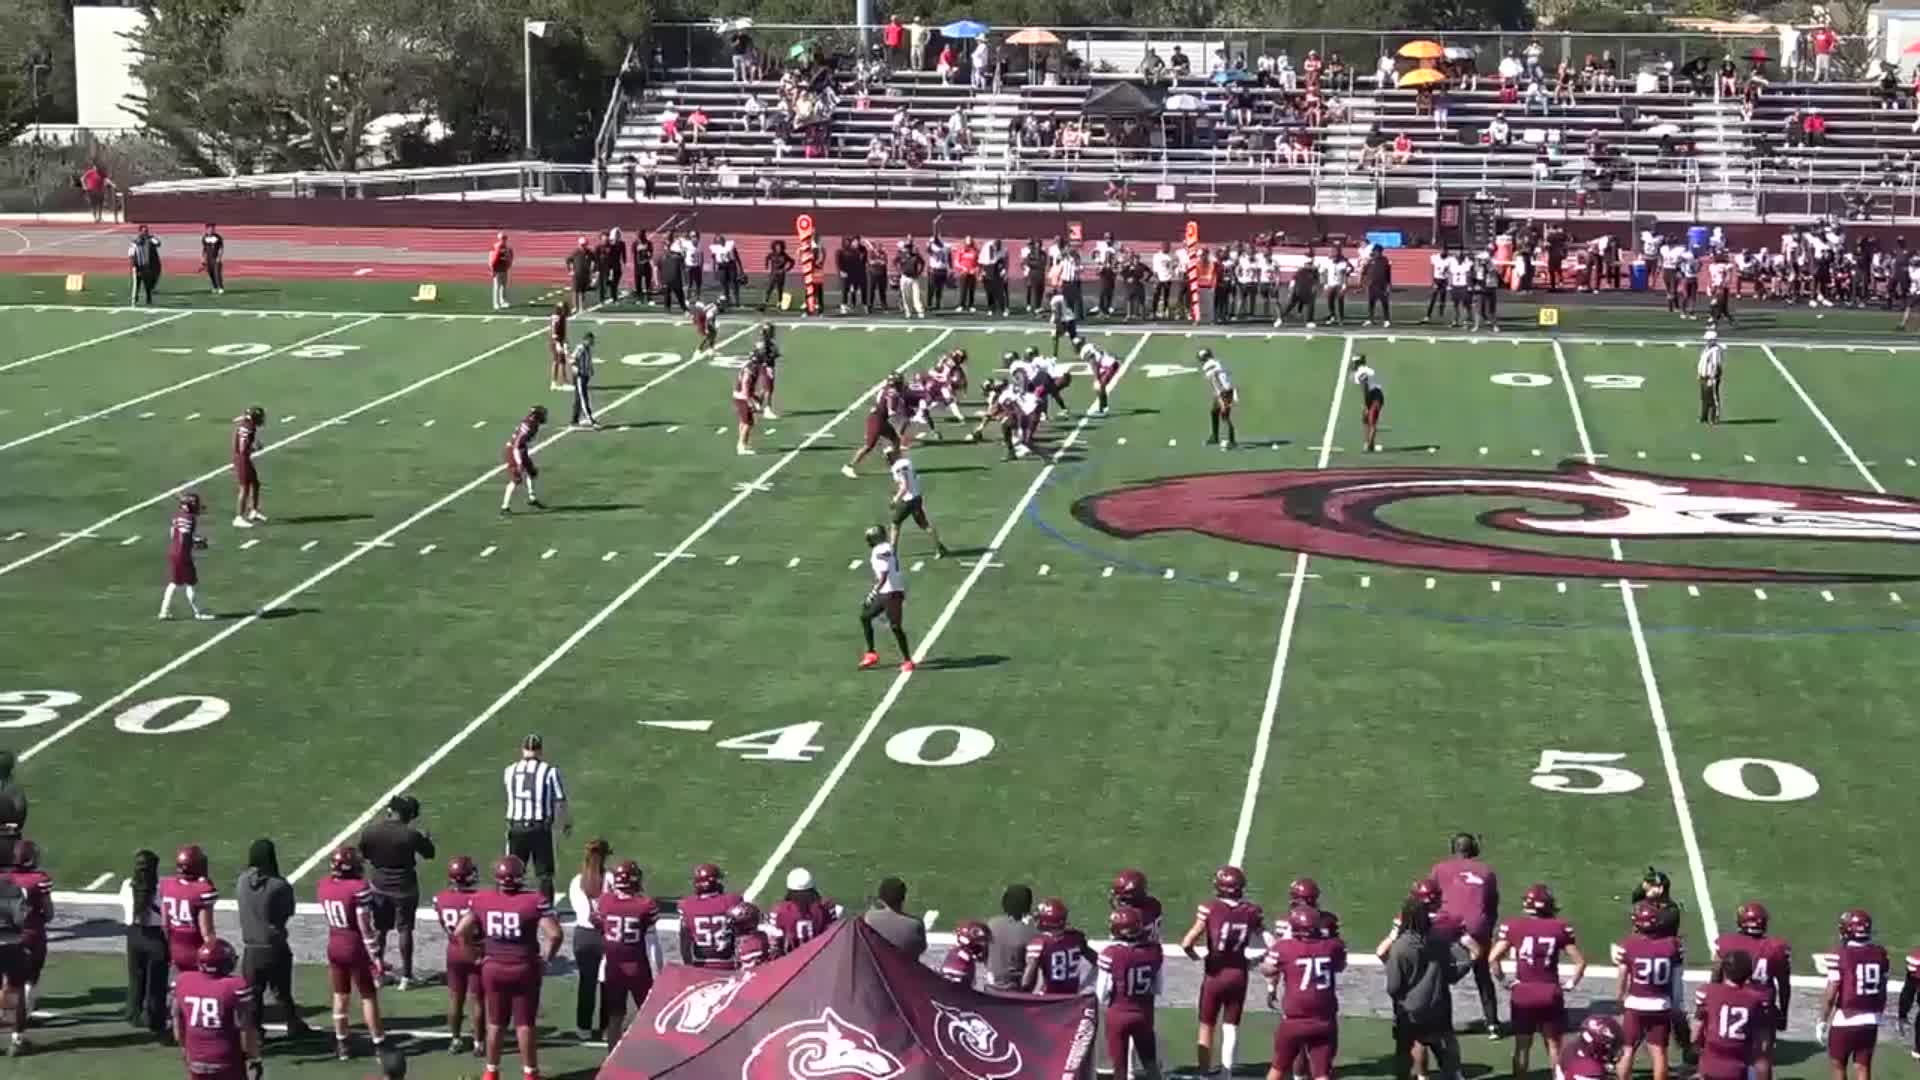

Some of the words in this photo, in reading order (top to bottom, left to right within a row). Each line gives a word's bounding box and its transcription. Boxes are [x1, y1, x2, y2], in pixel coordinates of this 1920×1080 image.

[324, 899, 348, 928] 10
[486, 911, 521, 938] 68
[606, 915, 640, 943] 35
[1218, 921, 1248, 951] 17
[1519, 936, 1556, 966] 47
[1127, 966, 1151, 995] 15
[1295, 957, 1331, 990] 75
[1856, 963, 1880, 995] 19
[184, 996, 222, 1028] 78
[1719, 1004, 1748, 1038] 12
